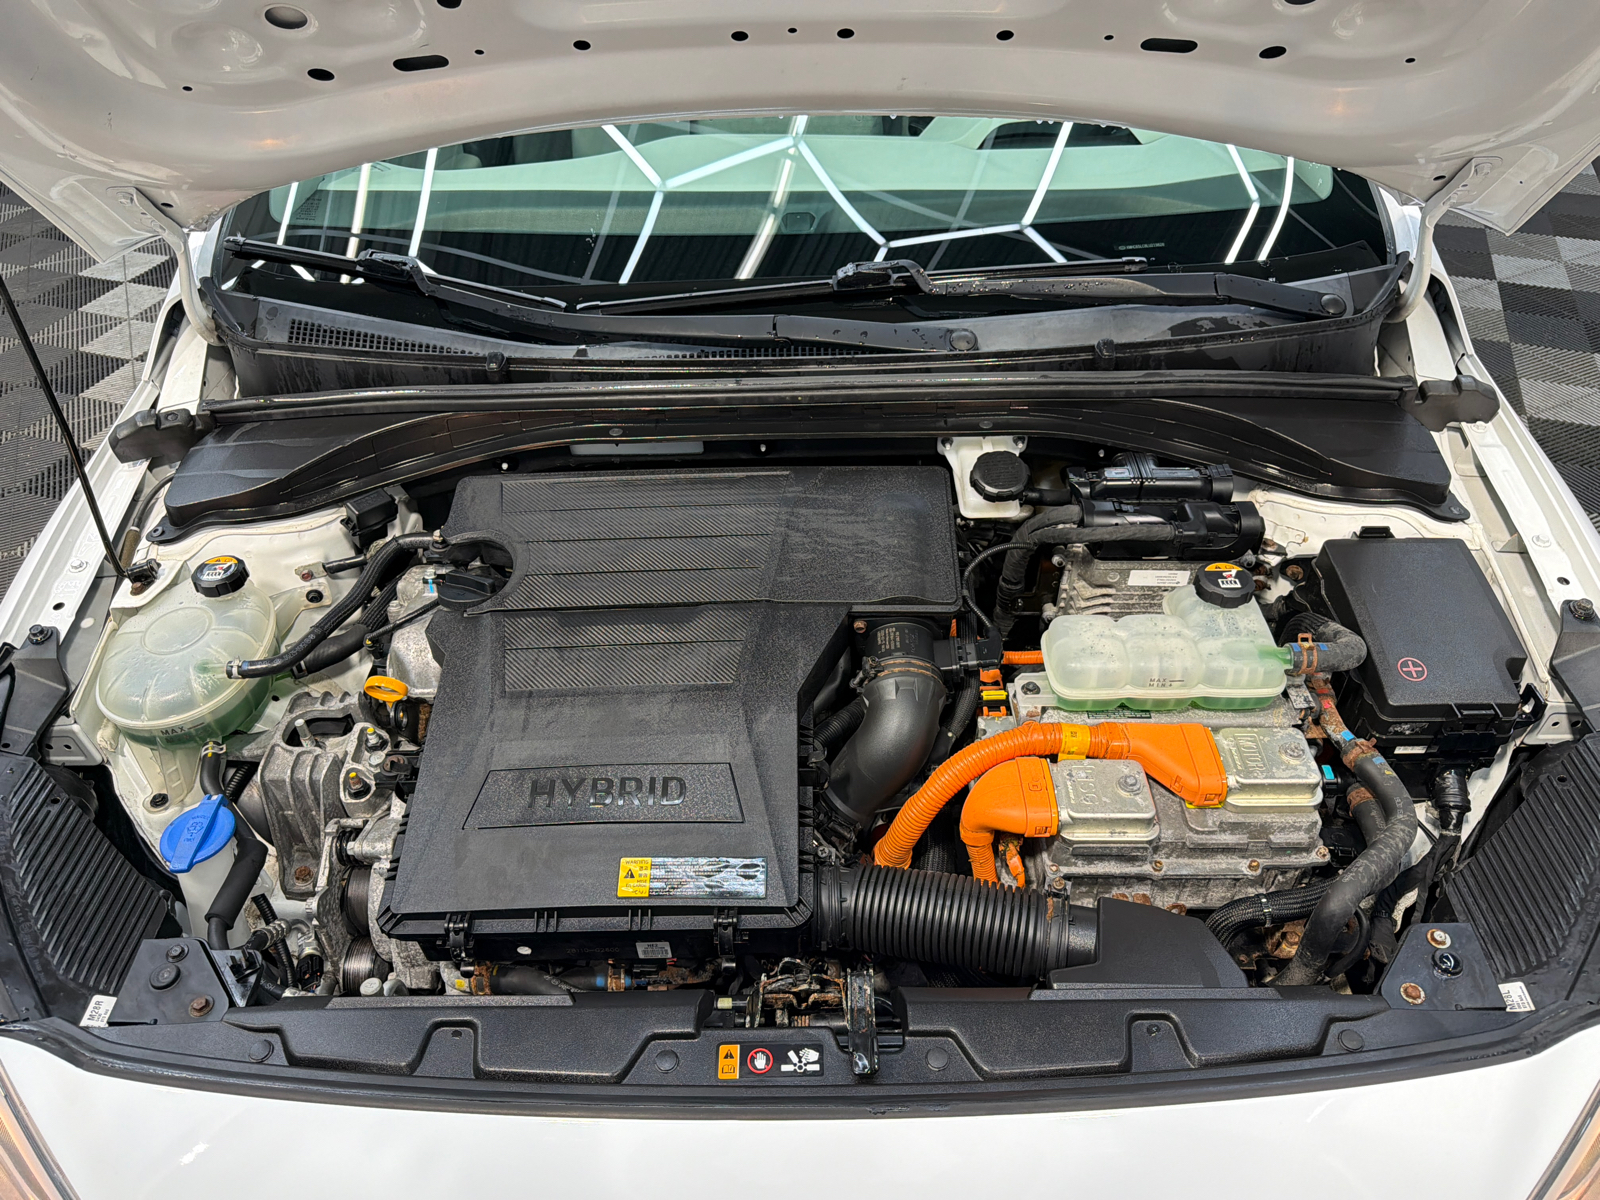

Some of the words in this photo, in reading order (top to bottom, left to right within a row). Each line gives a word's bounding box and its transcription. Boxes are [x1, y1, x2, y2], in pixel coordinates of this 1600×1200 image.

[160, 726, 187, 736] MAX
[1237, 737, 1266, 771] MOTOR
[528, 776, 687, 808] HYBRID
[87, 1000, 104, 1021] M28R
